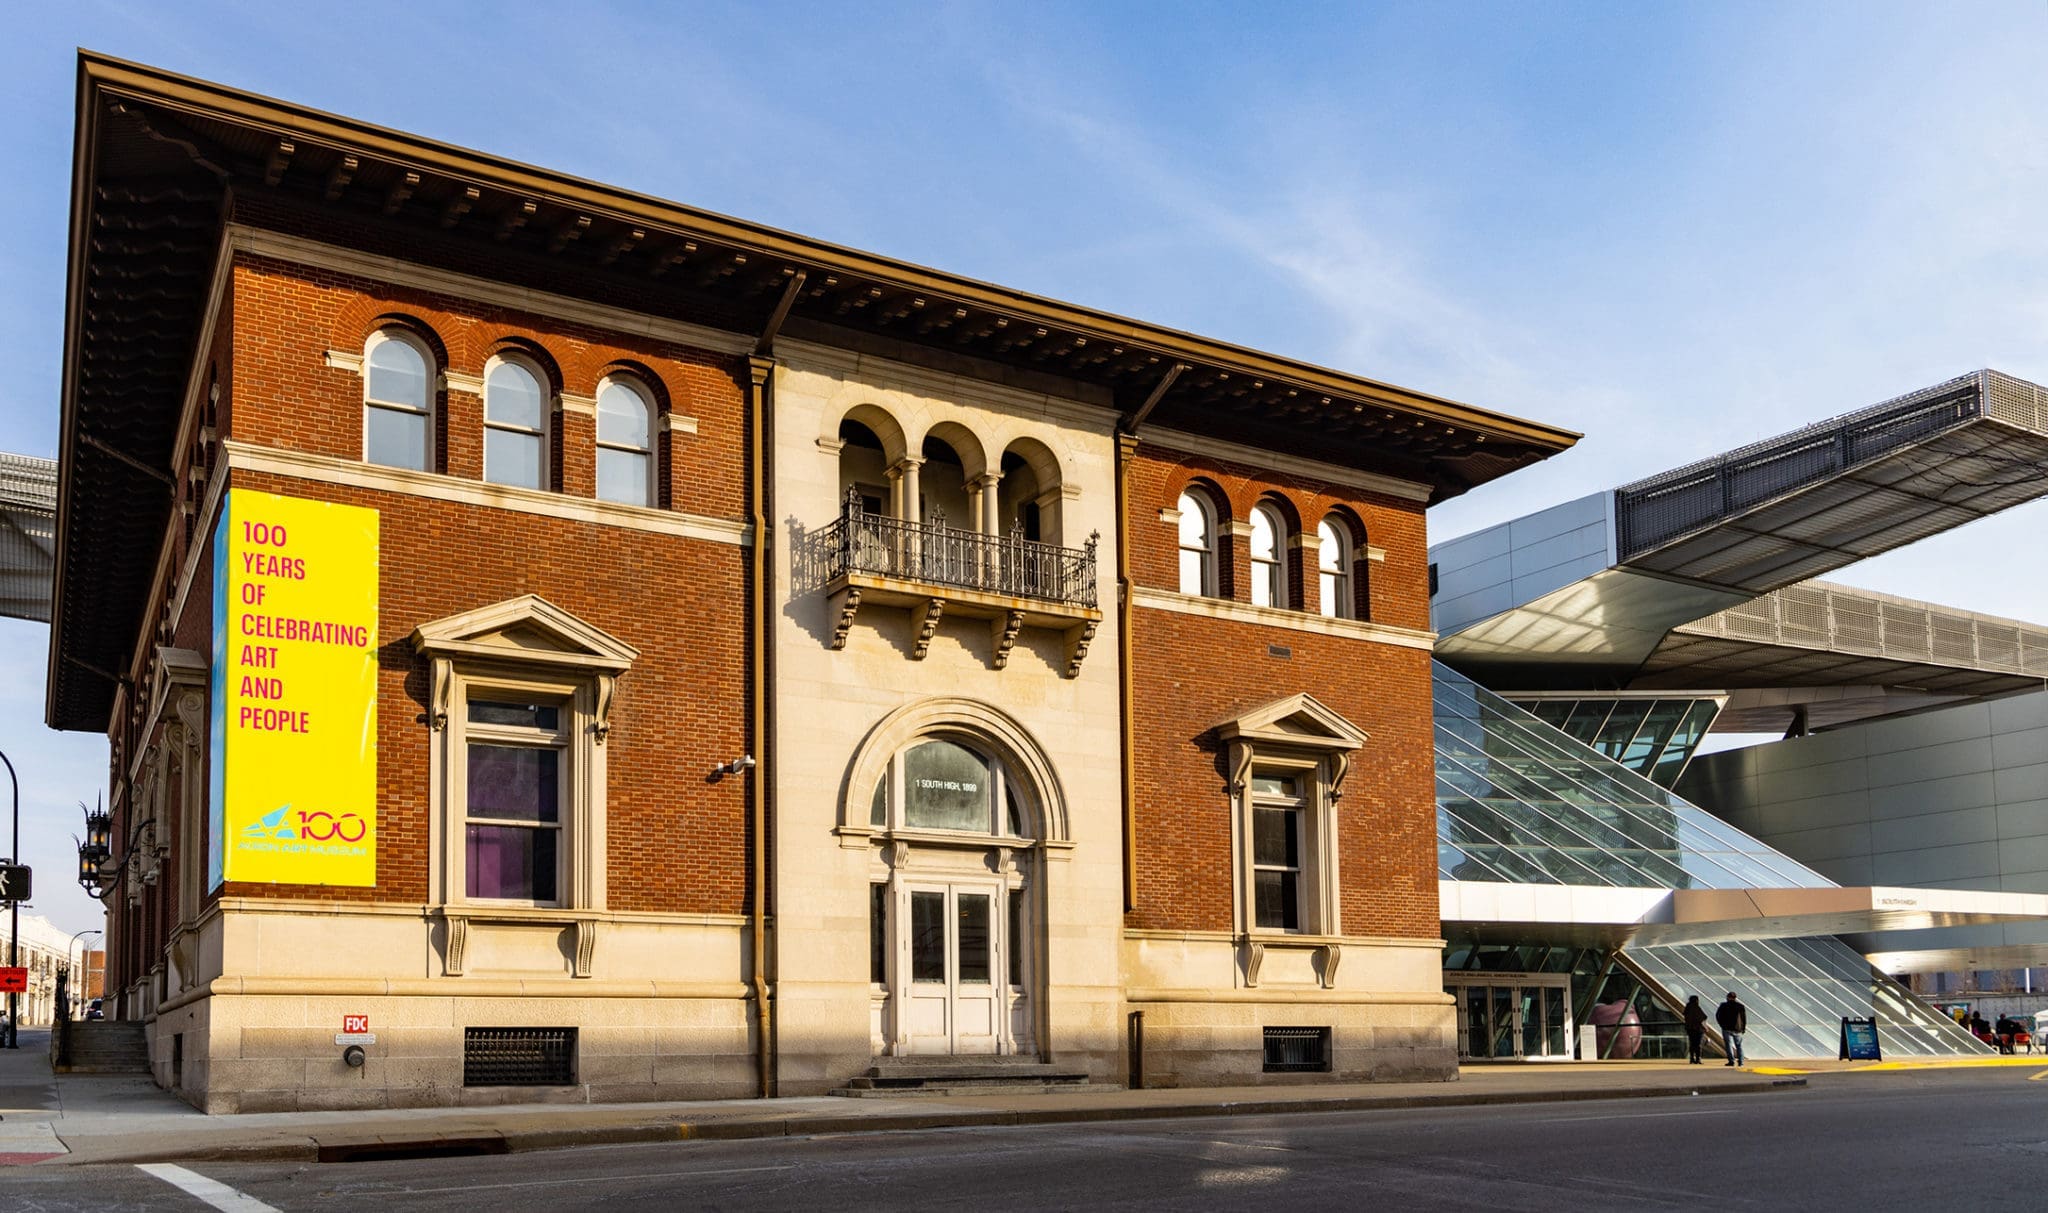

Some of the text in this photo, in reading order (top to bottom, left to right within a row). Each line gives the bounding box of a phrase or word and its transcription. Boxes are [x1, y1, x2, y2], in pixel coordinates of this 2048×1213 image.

[243, 521, 287, 548] 100
[242, 552, 306, 580] YEARS
[242, 583, 266, 606] OF
[241, 614, 368, 648] CELEBRATING
[240, 645, 279, 669] ART
[239, 676, 283, 700] AND
[240, 707, 310, 734] PEOPLE
[921, 780, 943, 789] SOUTH
[944, 781, 961, 791] HIGH,
[962, 783, 977, 792] 1899
[297, 811, 366, 842] 100
[282, 843, 307, 854] ART
[346, 1017, 367, 1031] FDC
